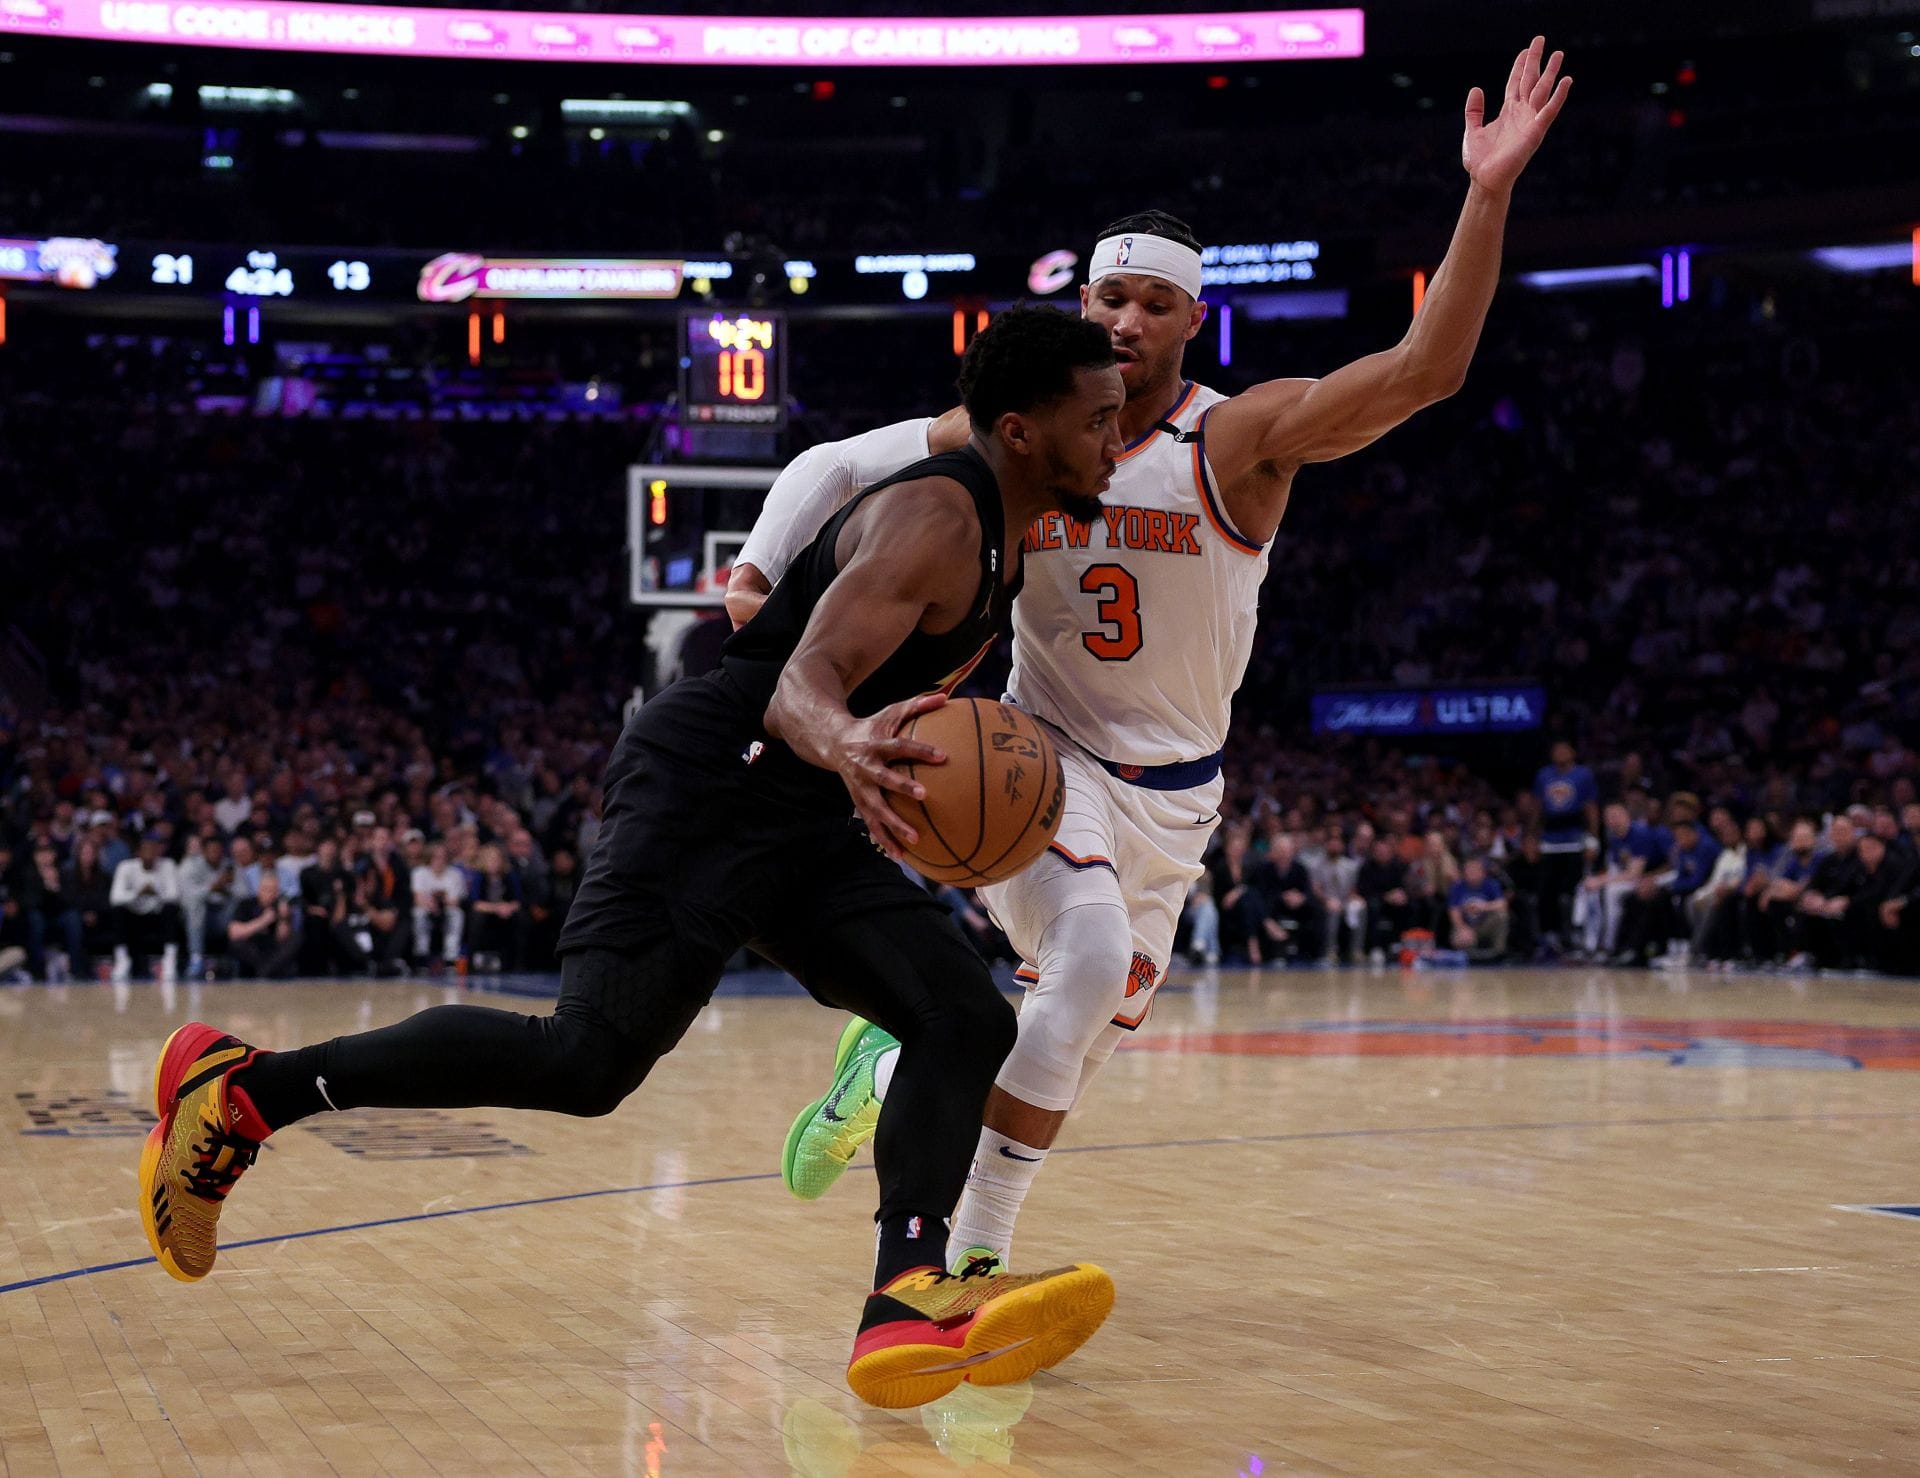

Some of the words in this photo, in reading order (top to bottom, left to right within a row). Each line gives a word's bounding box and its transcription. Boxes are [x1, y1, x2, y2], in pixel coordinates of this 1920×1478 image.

[100, 3, 169, 32] USE
[703, 27, 799, 57] PIECE
[802, 27, 849, 57] OF
[851, 27, 943, 57] CAKE
[946, 27, 1080, 57] MOVING
[152, 253, 193, 285] 21
[327, 260, 371, 290] 13
[718, 349, 766, 401] 10
[1101, 505, 1202, 556] YORK
[1079, 562, 1144, 661] 3
[1436, 695, 1533, 724] ULTRA
